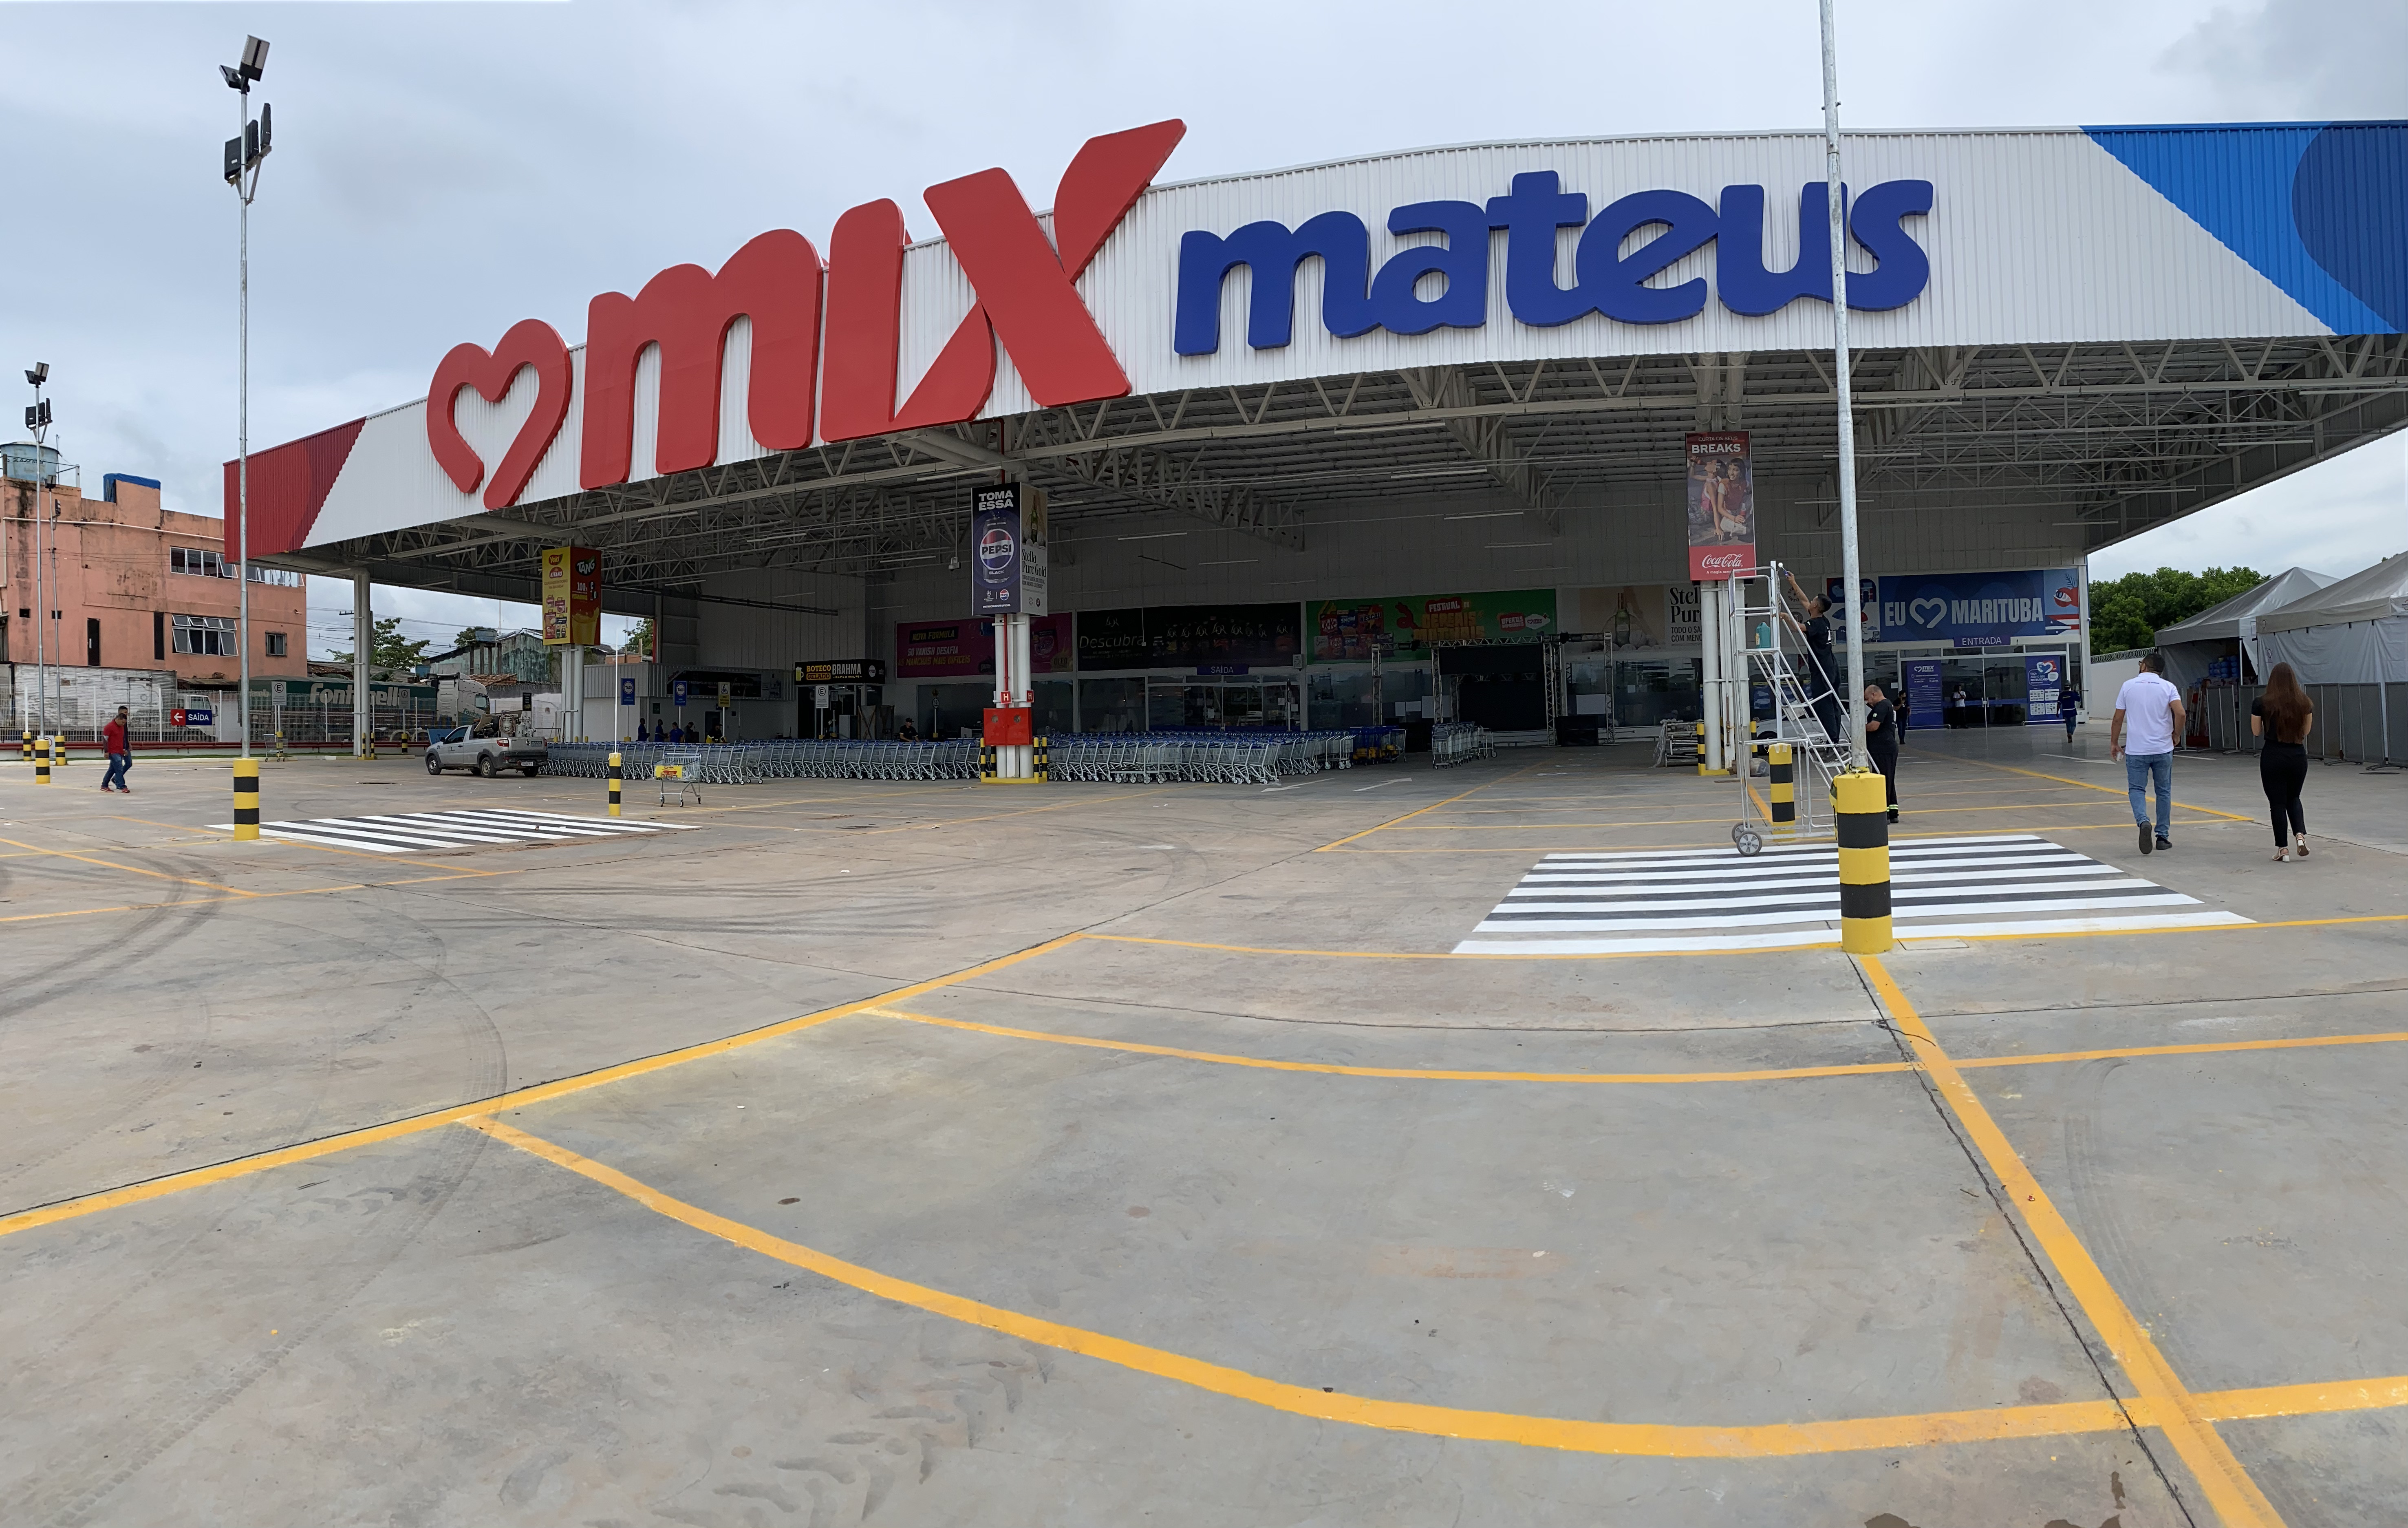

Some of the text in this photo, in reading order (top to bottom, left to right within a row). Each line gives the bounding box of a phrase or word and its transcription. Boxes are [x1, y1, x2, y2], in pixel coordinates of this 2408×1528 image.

[579, 118, 1933, 490] mix mateus
[1692, 443, 1741, 453] BREAKS
[978, 490, 1014, 501] TOMA
[979, 499, 1014, 511] ESSA
[982, 543, 1012, 555] PEPSI
[550, 555, 560, 564] Yoki
[1022, 549, 1036, 563] Stella
[1702, 553, 1744, 568] Coca-Cola
[577, 559, 595, 574] TANG
[1022, 561, 1046, 578] Pure Gold
[1429, 601, 1460, 612] FESTIVAL
[1884, 597, 2044, 626] EU MARITUBA
[1360, 612, 1381, 623] NESCAU
[1422, 611, 1476, 629] CEREAIS
[1671, 605, 1702, 623] Pur
[912, 632, 926, 641] NOVA
[1079, 633, 1144, 649] Descubra
[1962, 637, 2002, 646] ENTRADA
[916, 647, 935, 656] VANISH
[936, 646, 958, 655] DESAFIA
[906, 657, 932, 666] MANCHAS
[933, 656, 946, 665] MAIS
[832, 663, 862, 675] BRAHMA
[1211, 665, 1234, 673] SAÍDA
[188, 712, 209, 721] SAÍDA
